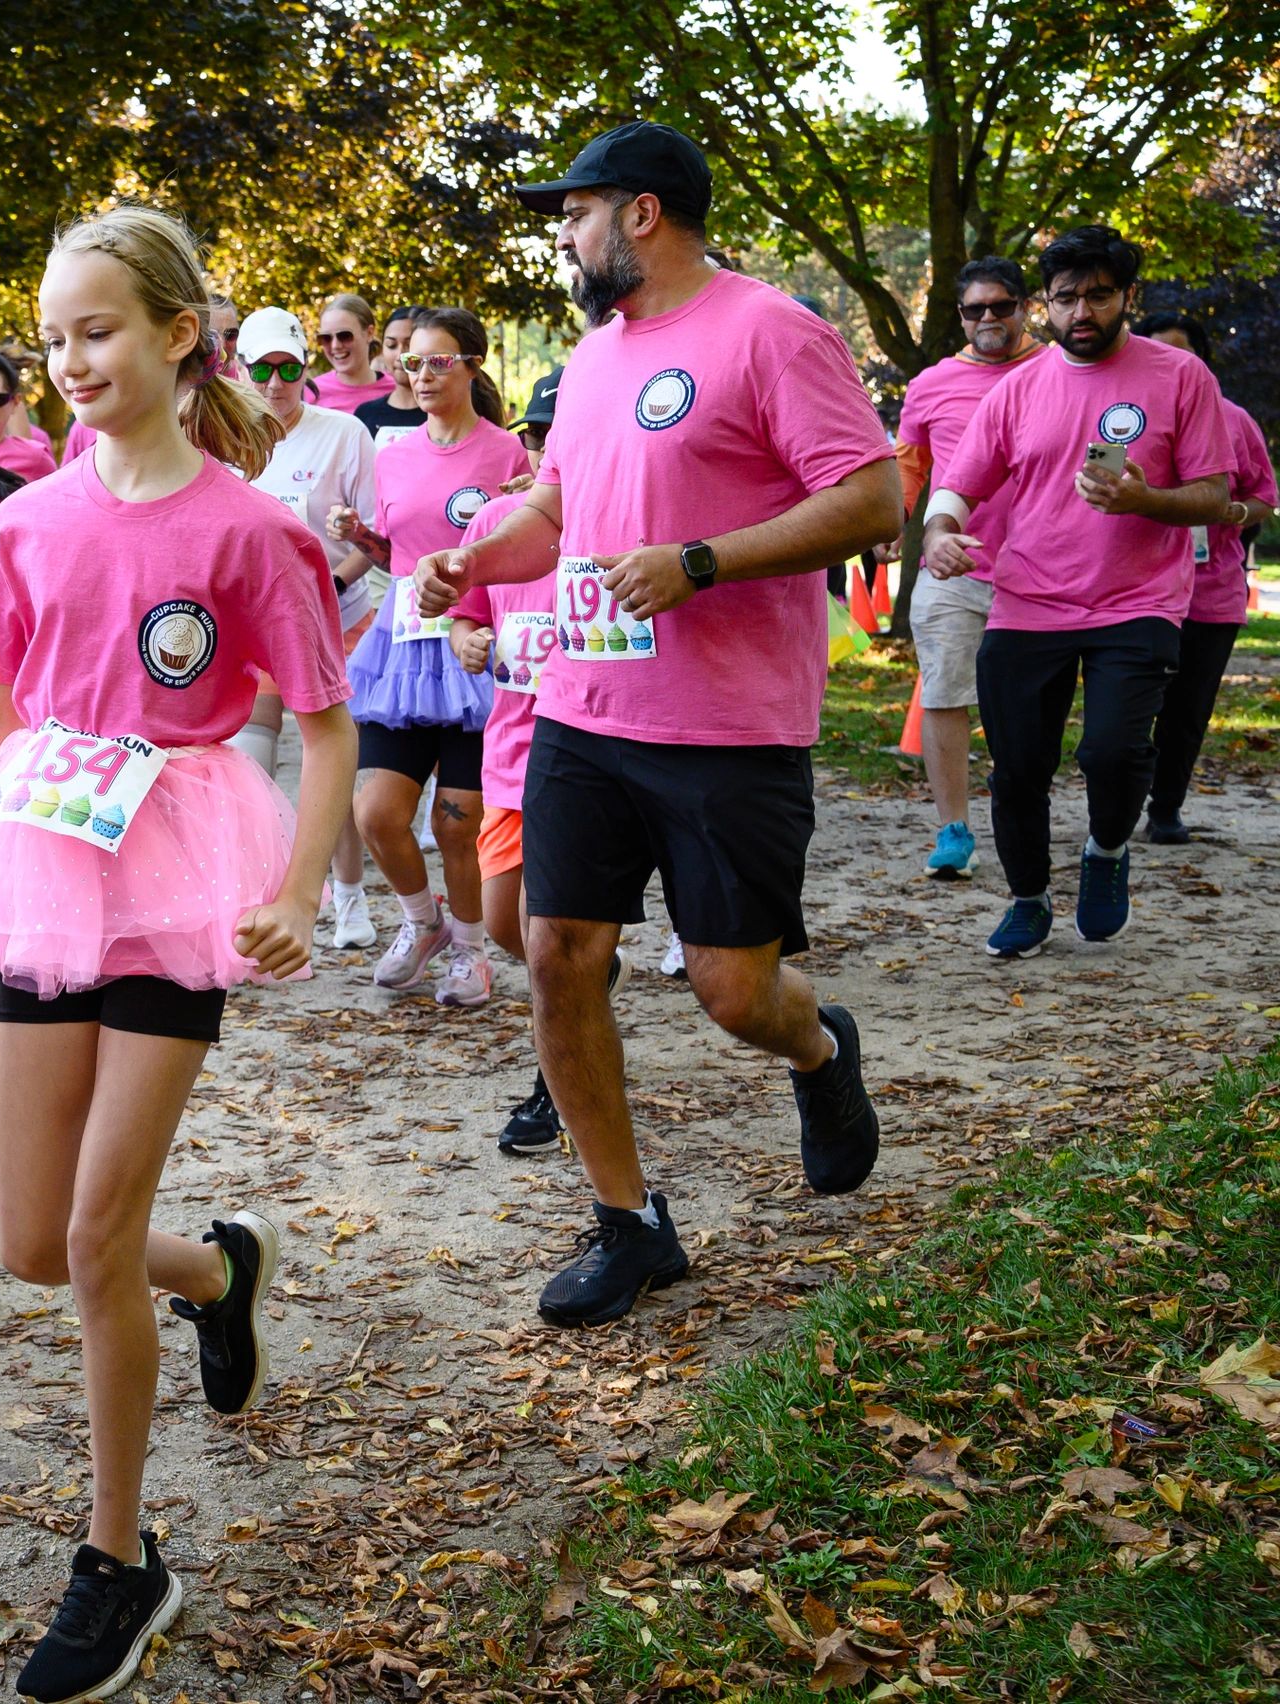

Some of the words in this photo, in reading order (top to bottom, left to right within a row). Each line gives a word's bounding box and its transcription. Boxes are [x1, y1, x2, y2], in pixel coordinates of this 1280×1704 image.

[150, 603, 197, 621] CUPCAKE
[198, 611, 215, 632] RUN
[163, 676, 174, 685] OF
[14, 733, 132, 797] 154
